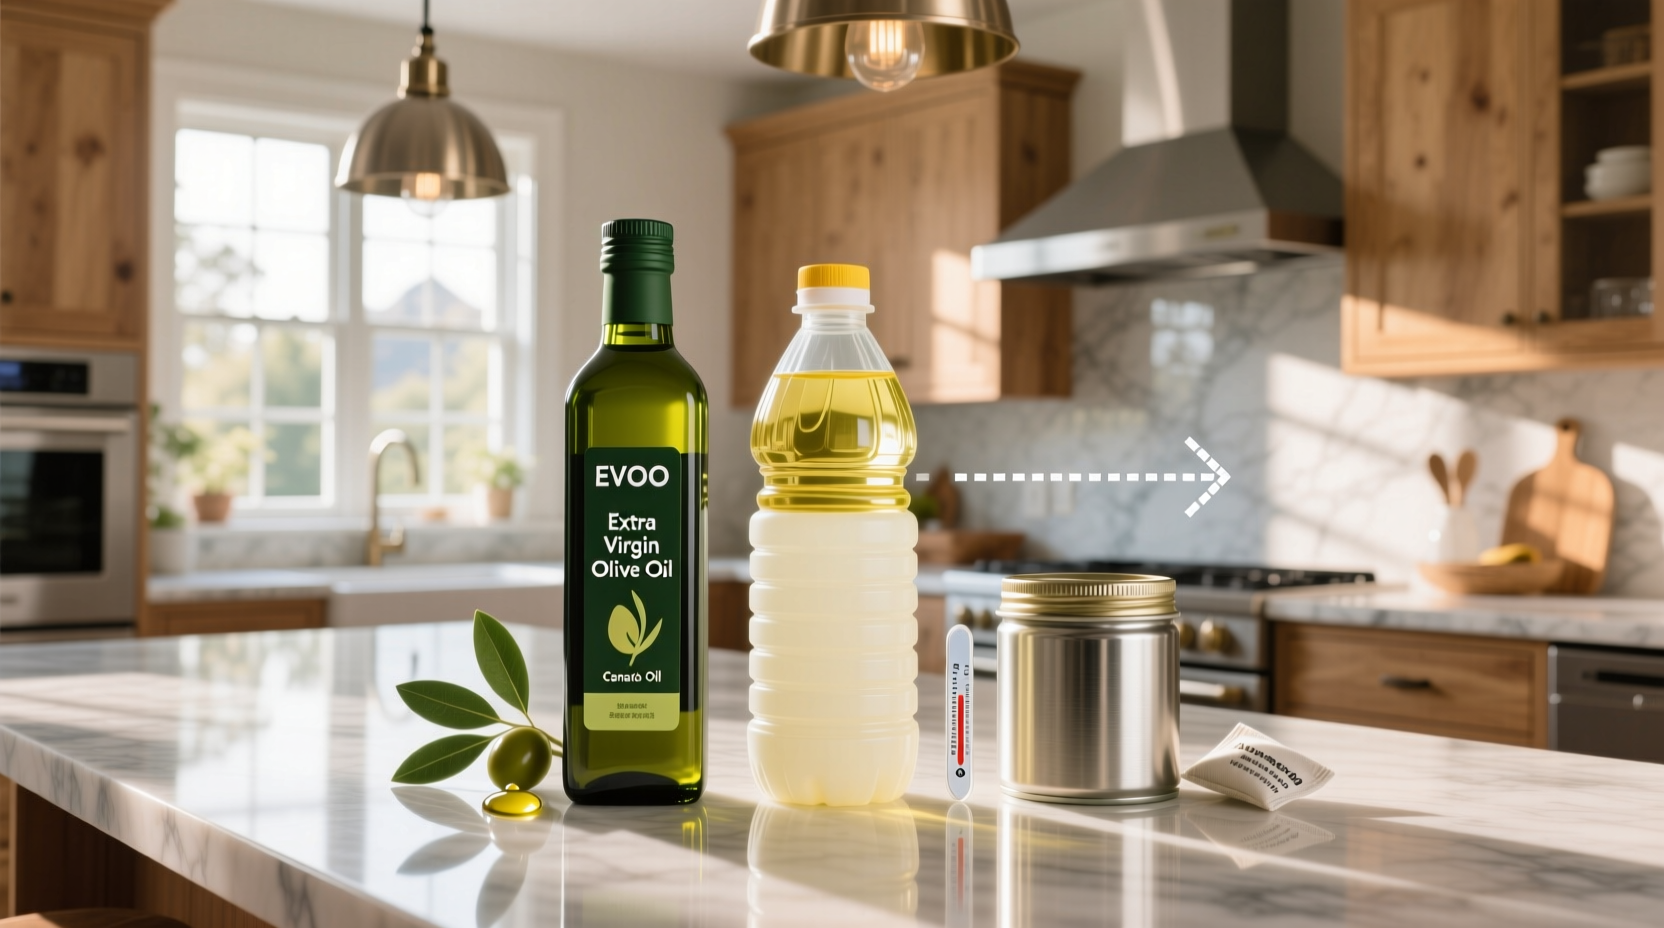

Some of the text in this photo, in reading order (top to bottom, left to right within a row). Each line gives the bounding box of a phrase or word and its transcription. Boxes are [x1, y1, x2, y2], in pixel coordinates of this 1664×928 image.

[596, 465, 669, 487] EVOO
[608, 512, 657, 531] Extra
[604, 535, 660, 559] Virgin
[591, 559, 673, 578] Olive Oil
[645, 670, 662, 683] Oil
